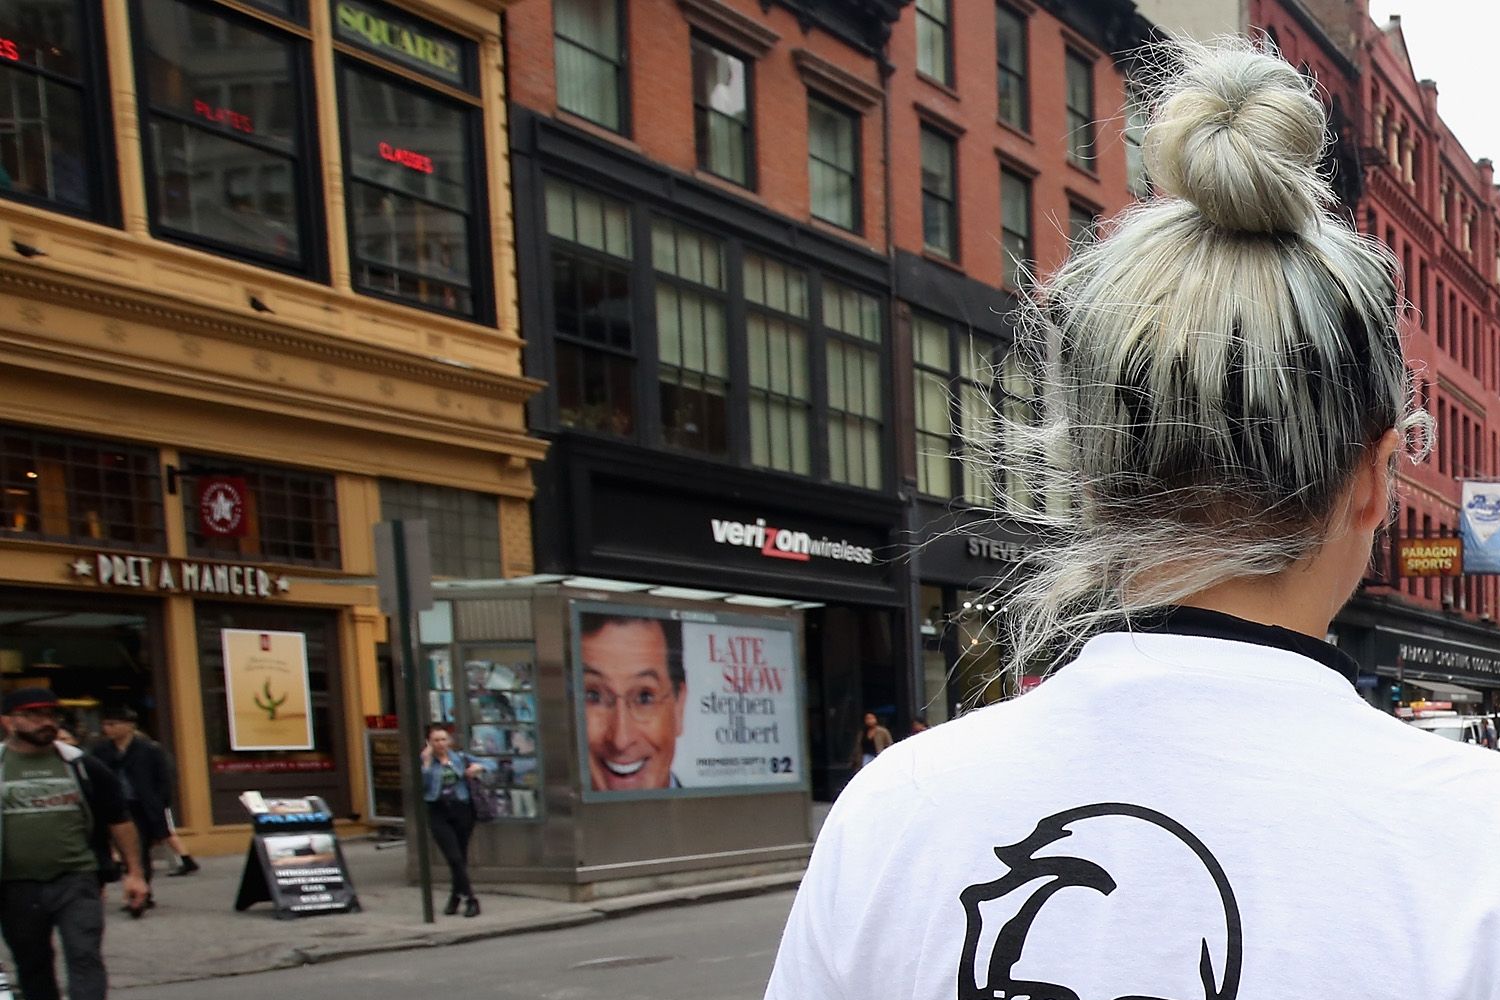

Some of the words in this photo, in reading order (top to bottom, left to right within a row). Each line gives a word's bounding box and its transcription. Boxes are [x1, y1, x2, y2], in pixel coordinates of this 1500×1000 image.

[337, 3, 460, 75] SQUARE
[379, 142, 434, 175] CLASSES
[1402, 546, 1458, 558] PARAGON
[1407, 557, 1453, 570] SPORTS
[96, 552, 151, 587] PRET
[158, 560, 175, 590] A
[181, 561, 272, 597] MANGER
[708, 633, 768, 665] LATE
[722, 663, 784, 693] SHOW
[700, 688, 776, 726] stephen
